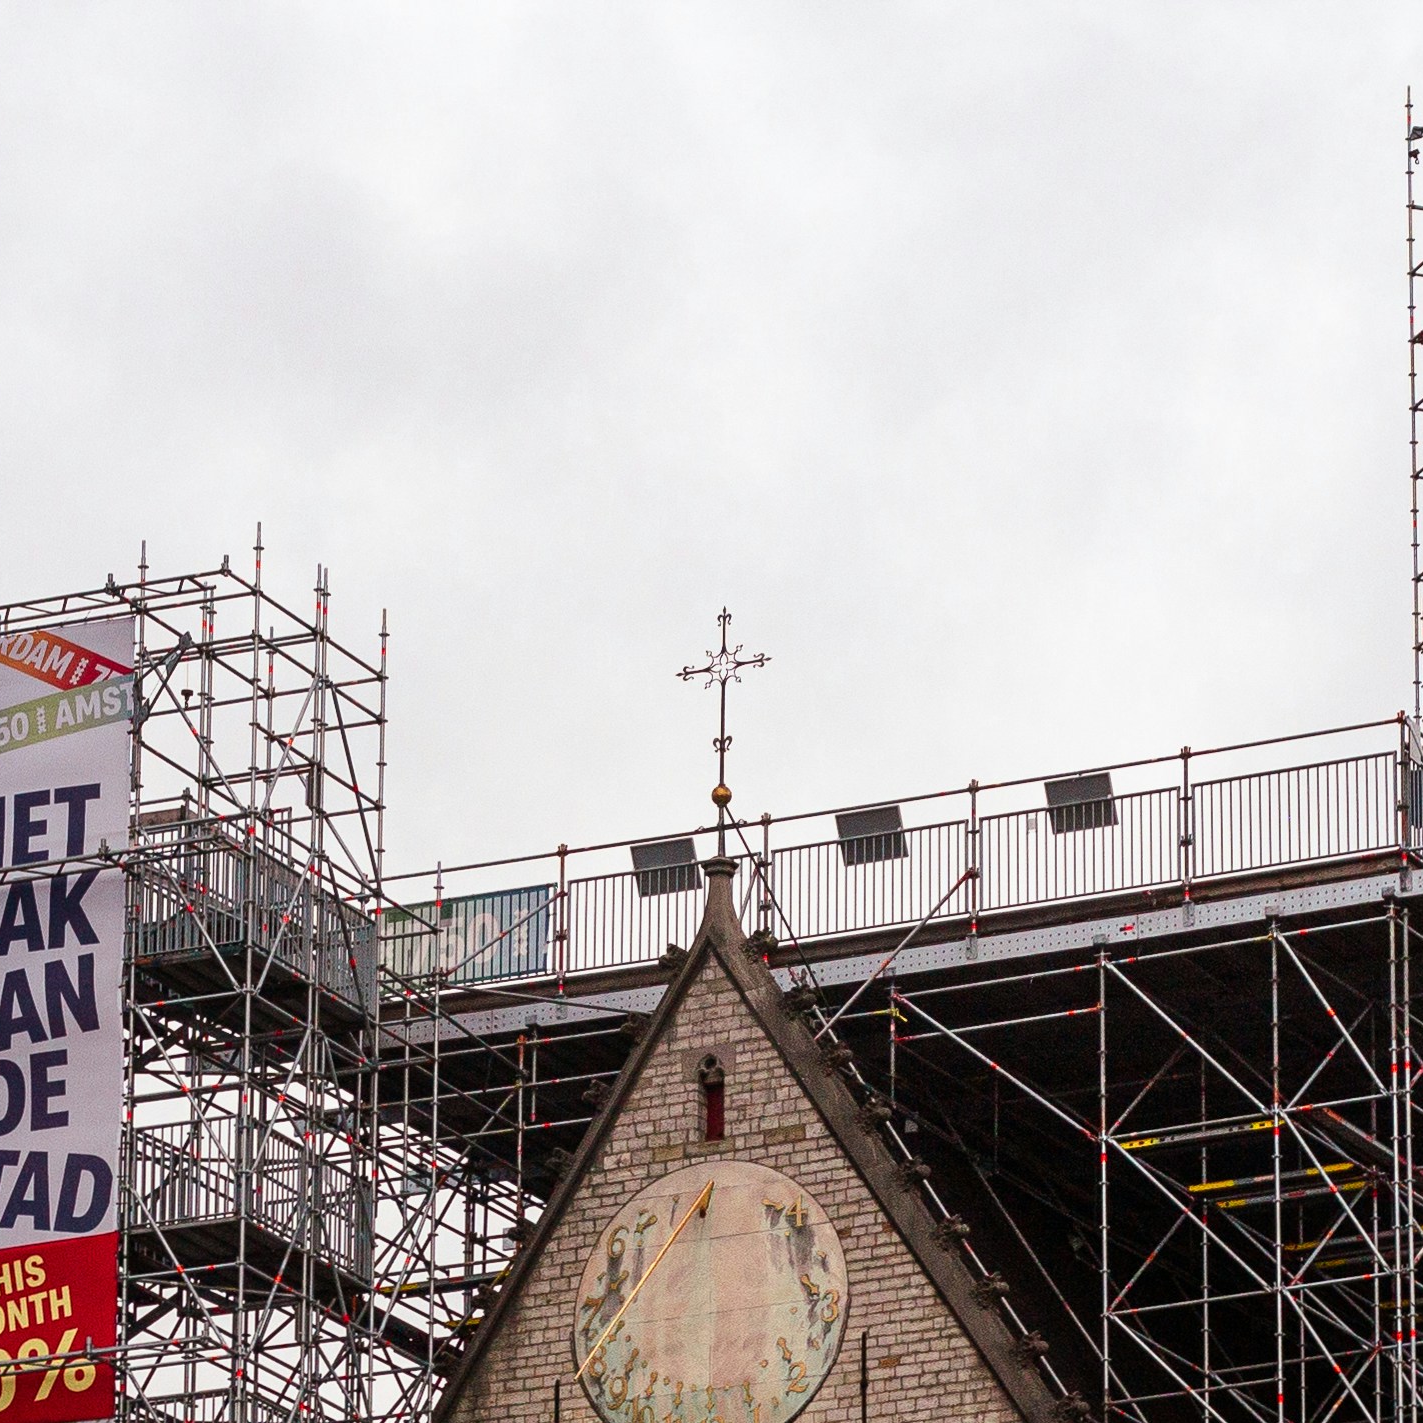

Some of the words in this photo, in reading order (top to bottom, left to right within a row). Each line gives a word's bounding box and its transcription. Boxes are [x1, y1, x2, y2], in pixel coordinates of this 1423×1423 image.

[785, 1194, 809, 1229] 4
[607, 1225, 629, 1260] 6
[581, 1295, 606, 1332] 7
[820, 1288, 840, 1324] 3
[587, 1344, 607, 1378] 8
[787, 1360, 809, 1394] 2
[607, 1375, 629, 1411] 9
